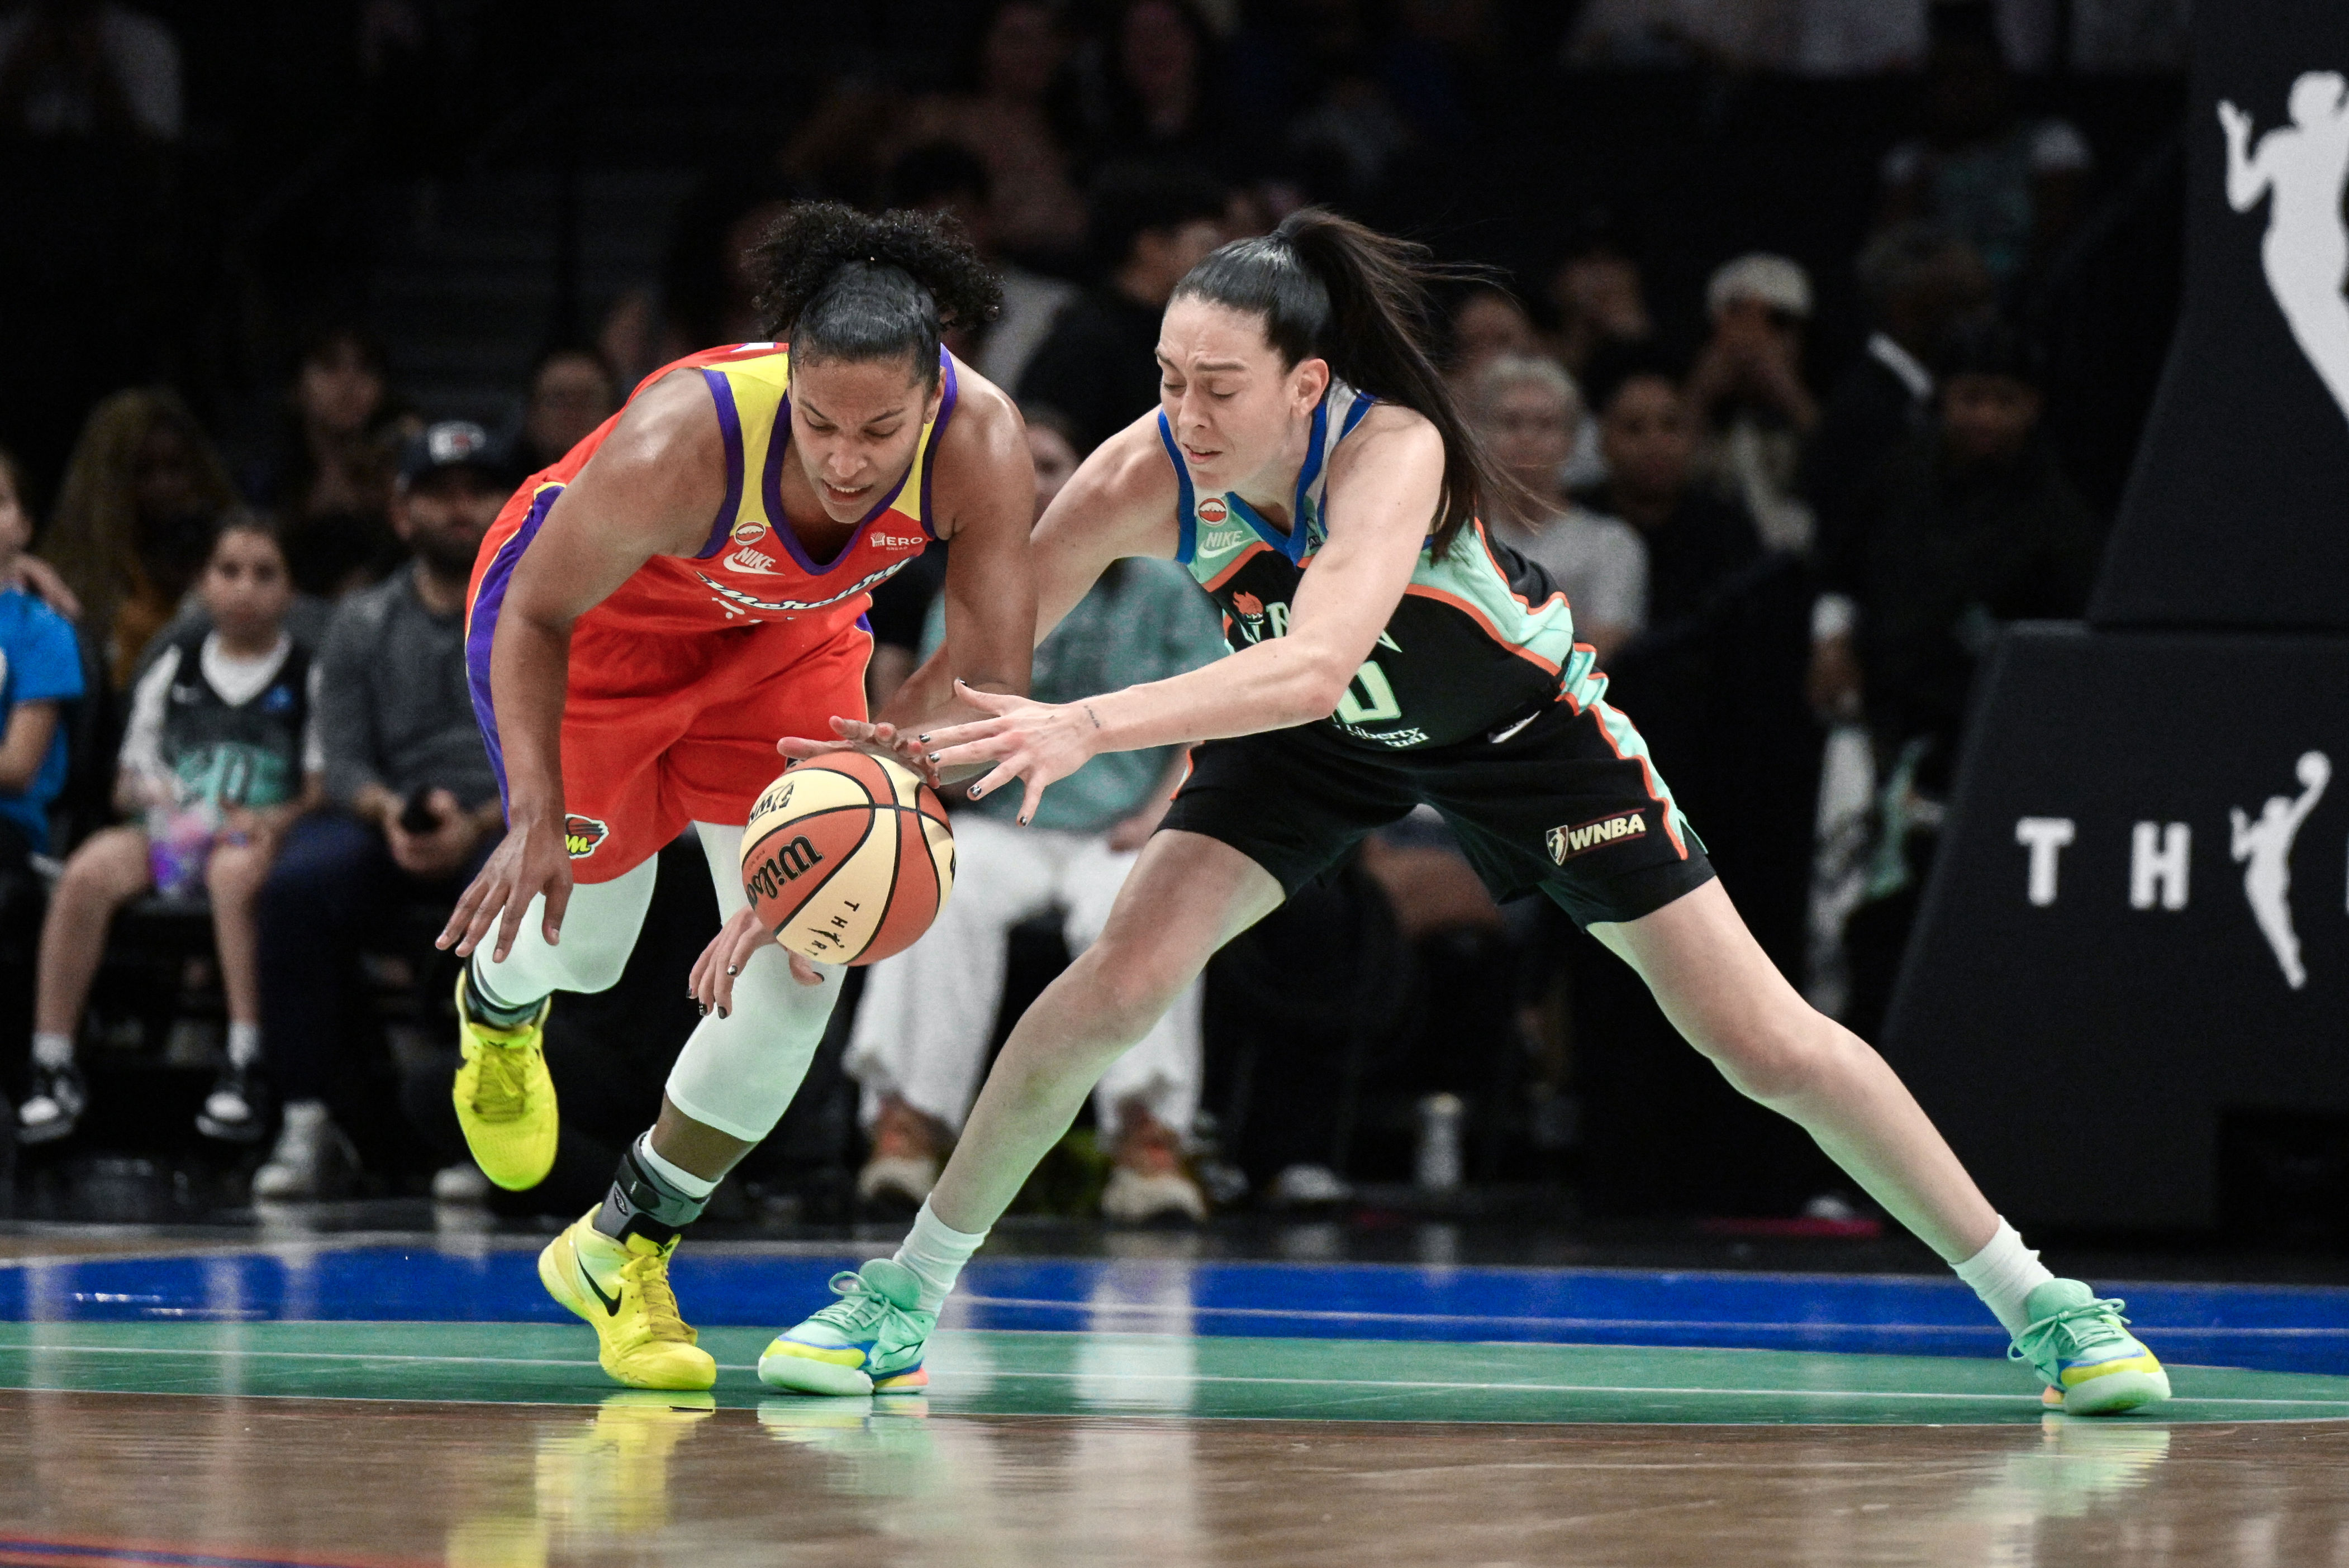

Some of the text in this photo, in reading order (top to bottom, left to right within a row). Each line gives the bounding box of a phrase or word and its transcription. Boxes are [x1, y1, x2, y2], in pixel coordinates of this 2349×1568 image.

[871, 532, 923, 547] HERO
[1205, 530, 1243, 547] NIKE
[734, 546, 776, 571] NIKE
[1569, 813, 1646, 850] WNBA
